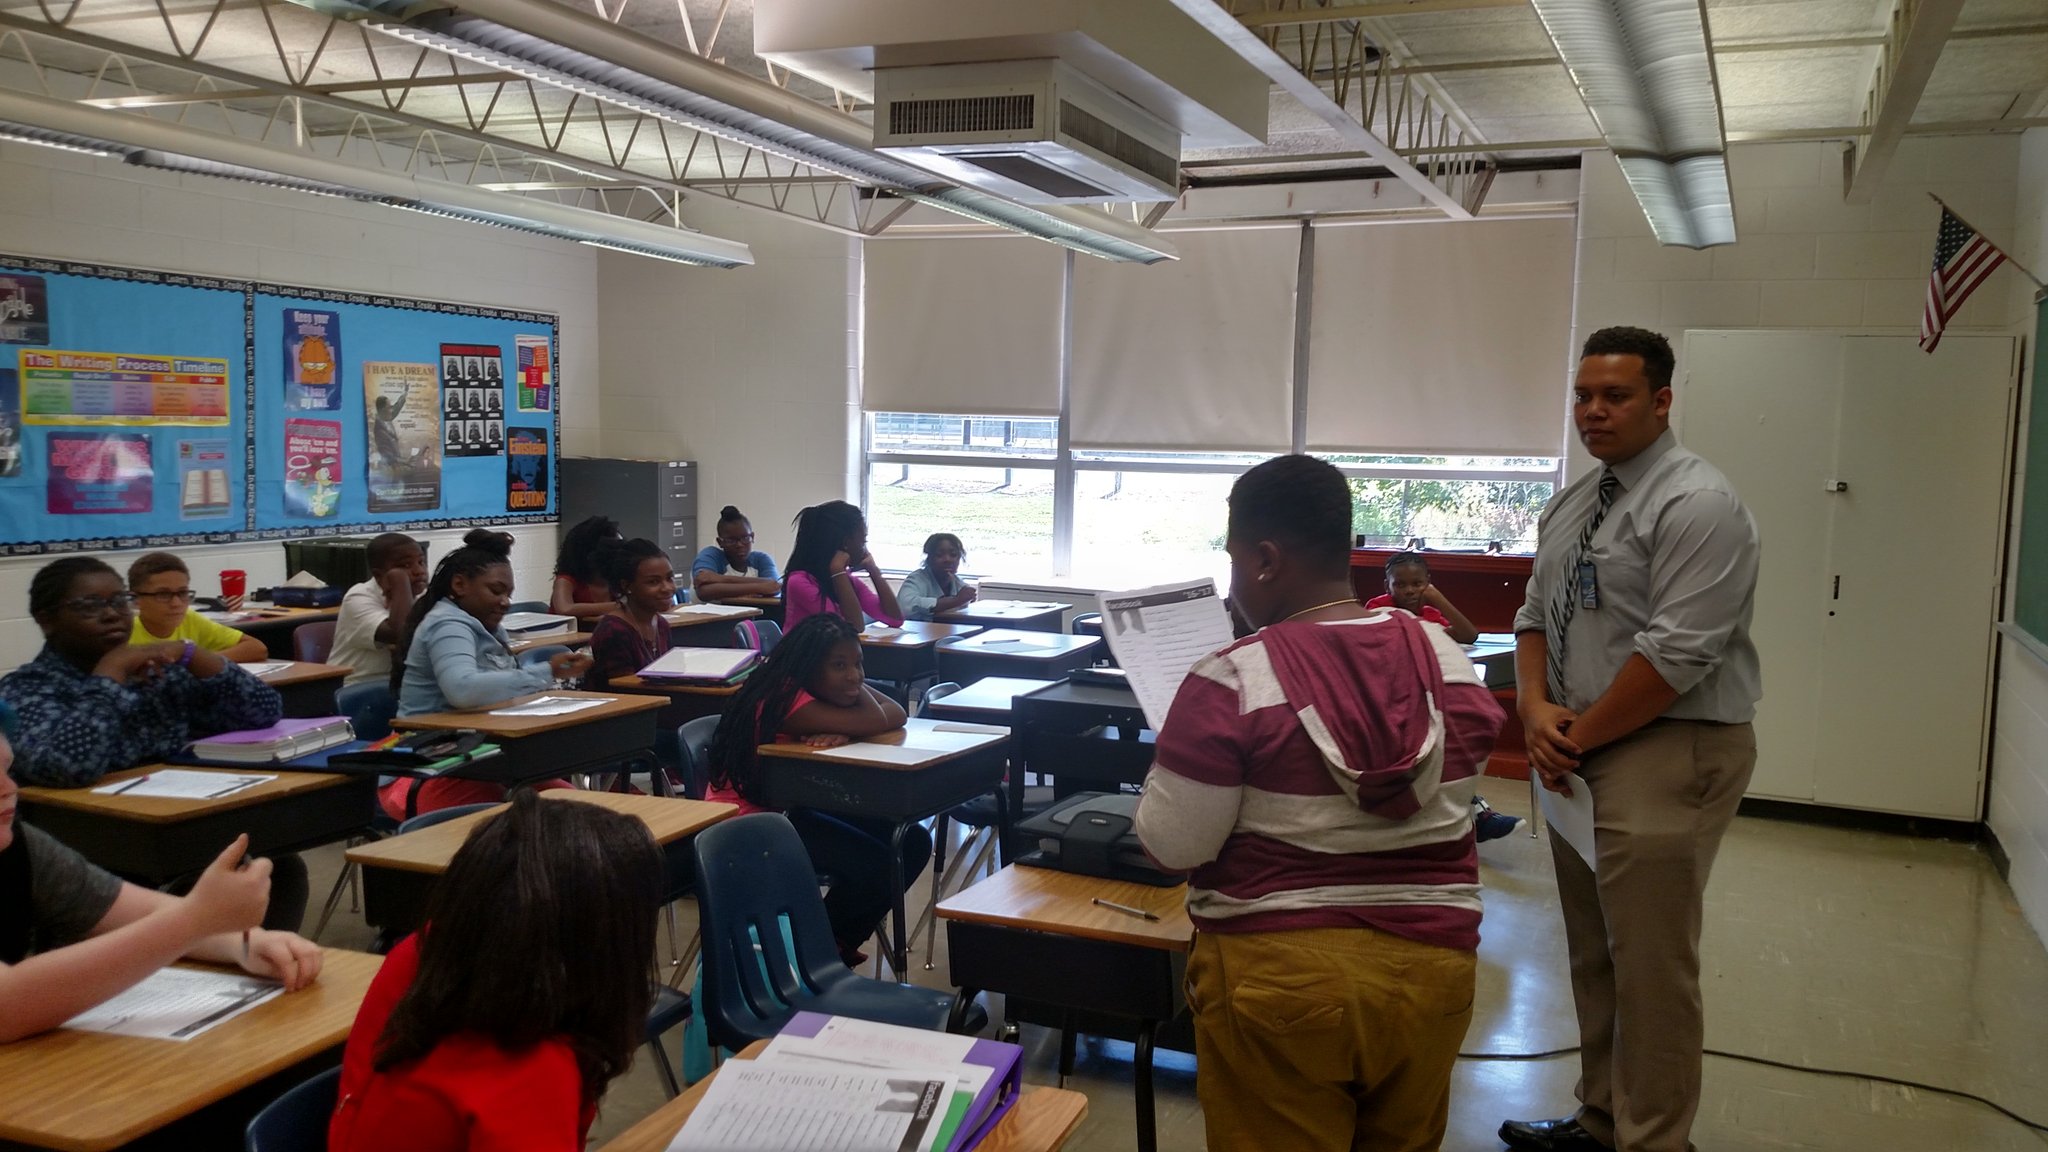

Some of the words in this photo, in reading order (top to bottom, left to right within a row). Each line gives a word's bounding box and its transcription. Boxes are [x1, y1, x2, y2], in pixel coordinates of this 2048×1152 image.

[25, 353, 54, 366] The
[60, 355, 112, 372] Writing
[117, 357, 170, 371] Process
[174, 360, 225, 373] Timeline
[372, 365, 396, 375] HAVE
[398, 366, 404, 375] A
[405, 366, 435, 376] DREAM
[509, 437, 547, 455] Einstein
[510, 490, 546, 508] QUESTIONS
[917, 1081, 941, 1120] facebook
